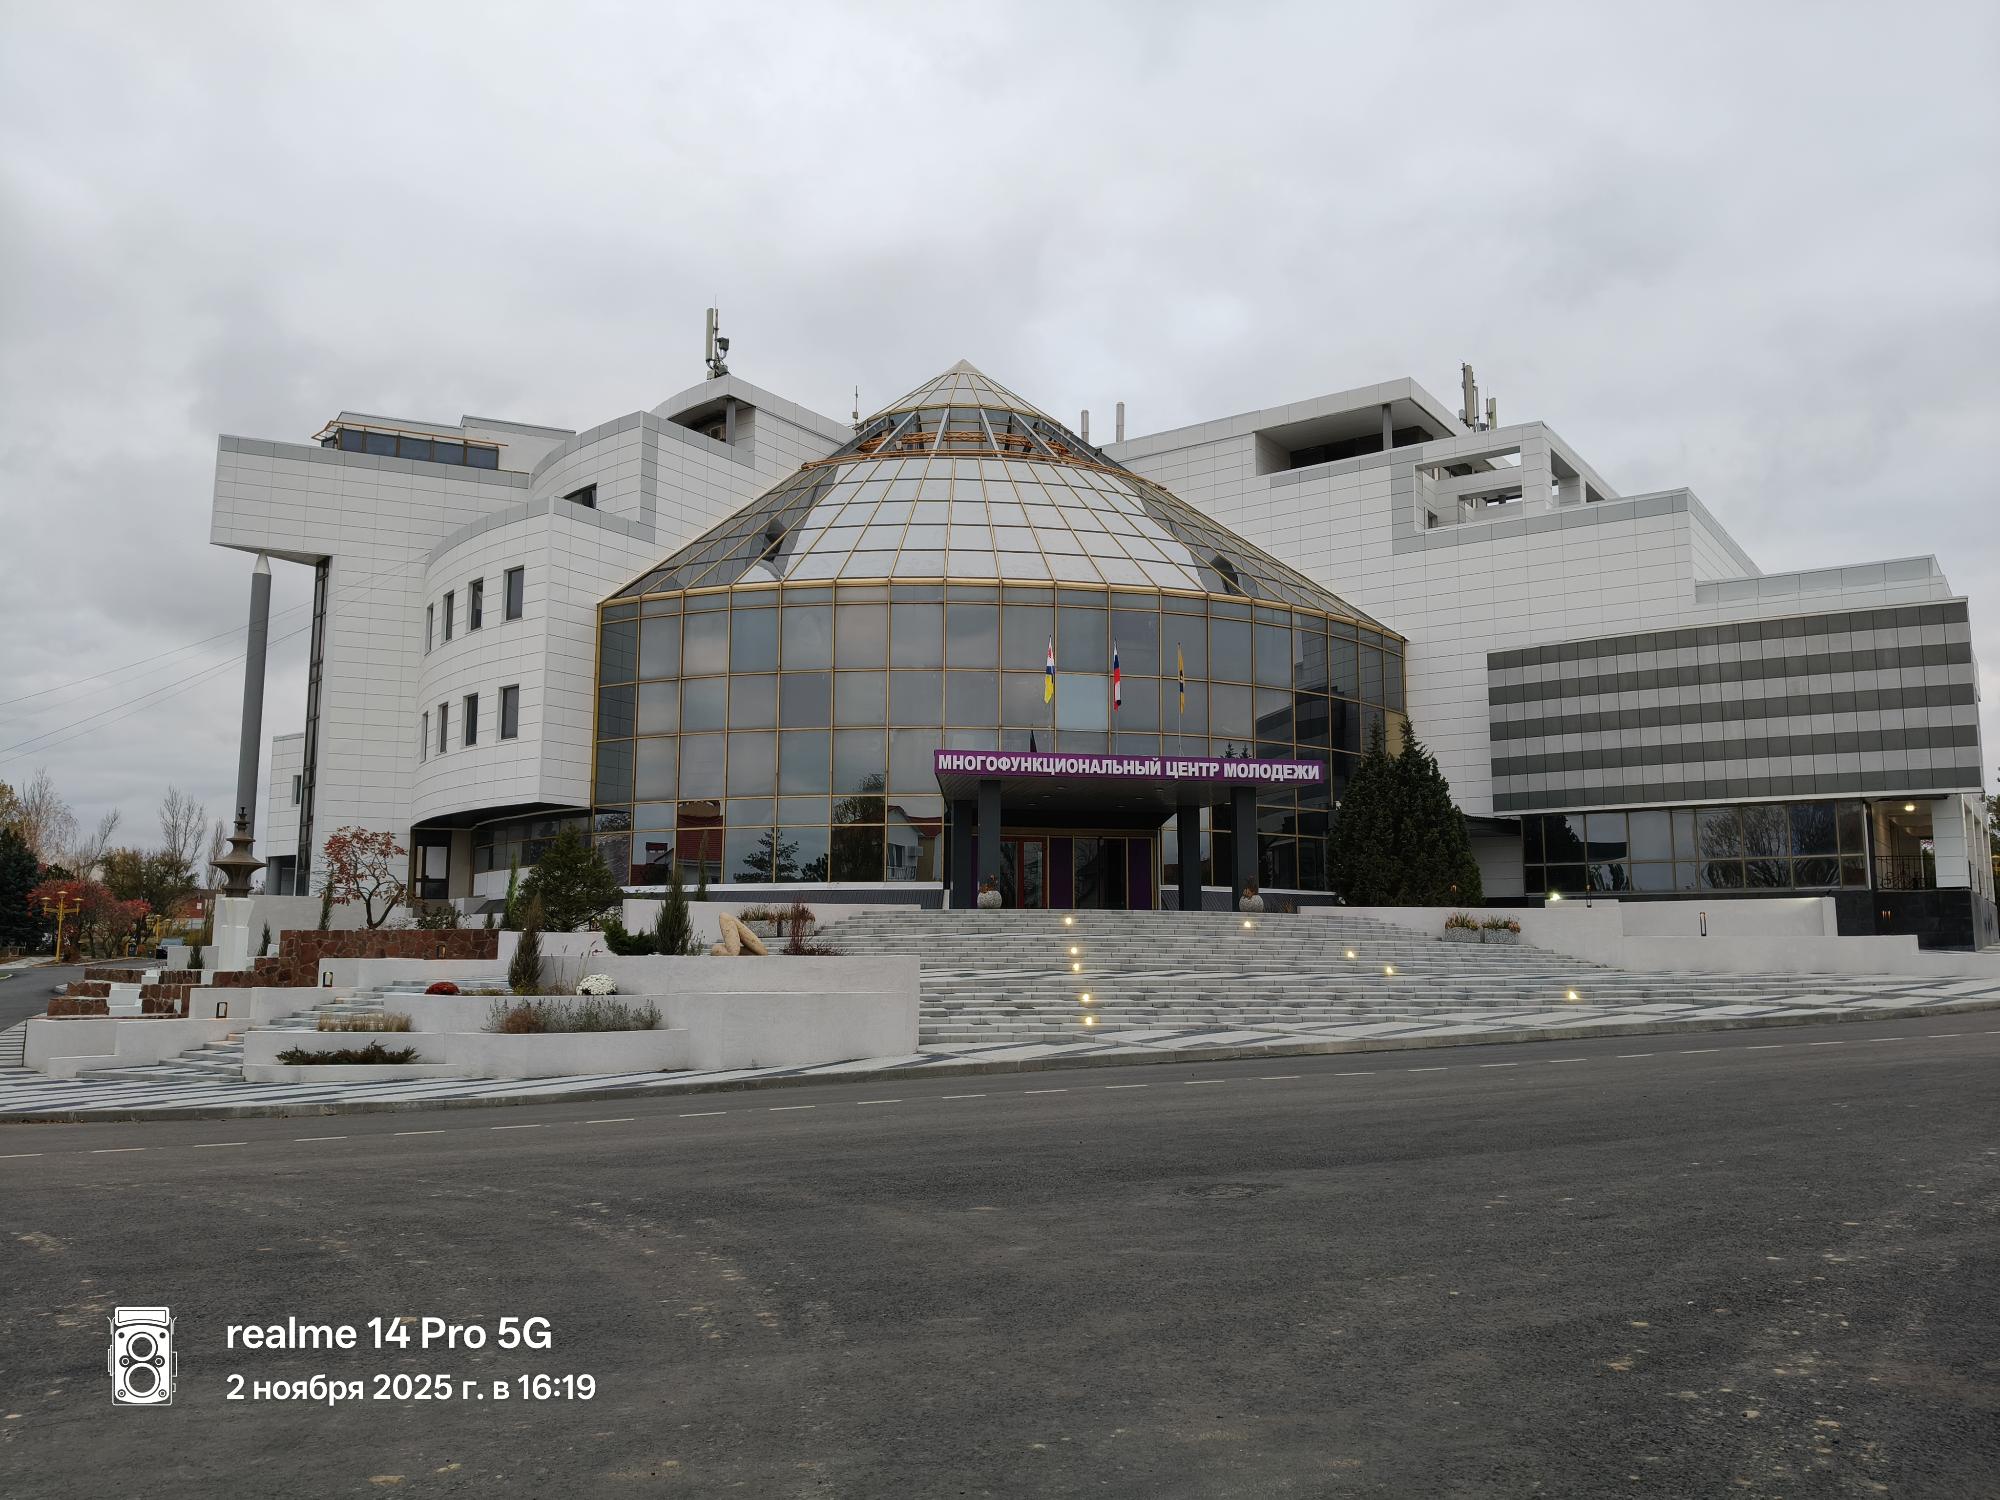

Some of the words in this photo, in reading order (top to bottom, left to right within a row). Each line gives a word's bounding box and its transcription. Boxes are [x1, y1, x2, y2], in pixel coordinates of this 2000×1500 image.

[938, 754, 1162, 776] МНОГОФУНКЦИОНАЛЬНЫЙ
[1165, 761, 1220, 779] ЦЕНТР
[1223, 763, 1320, 781] МОЛОДЕЖИ
